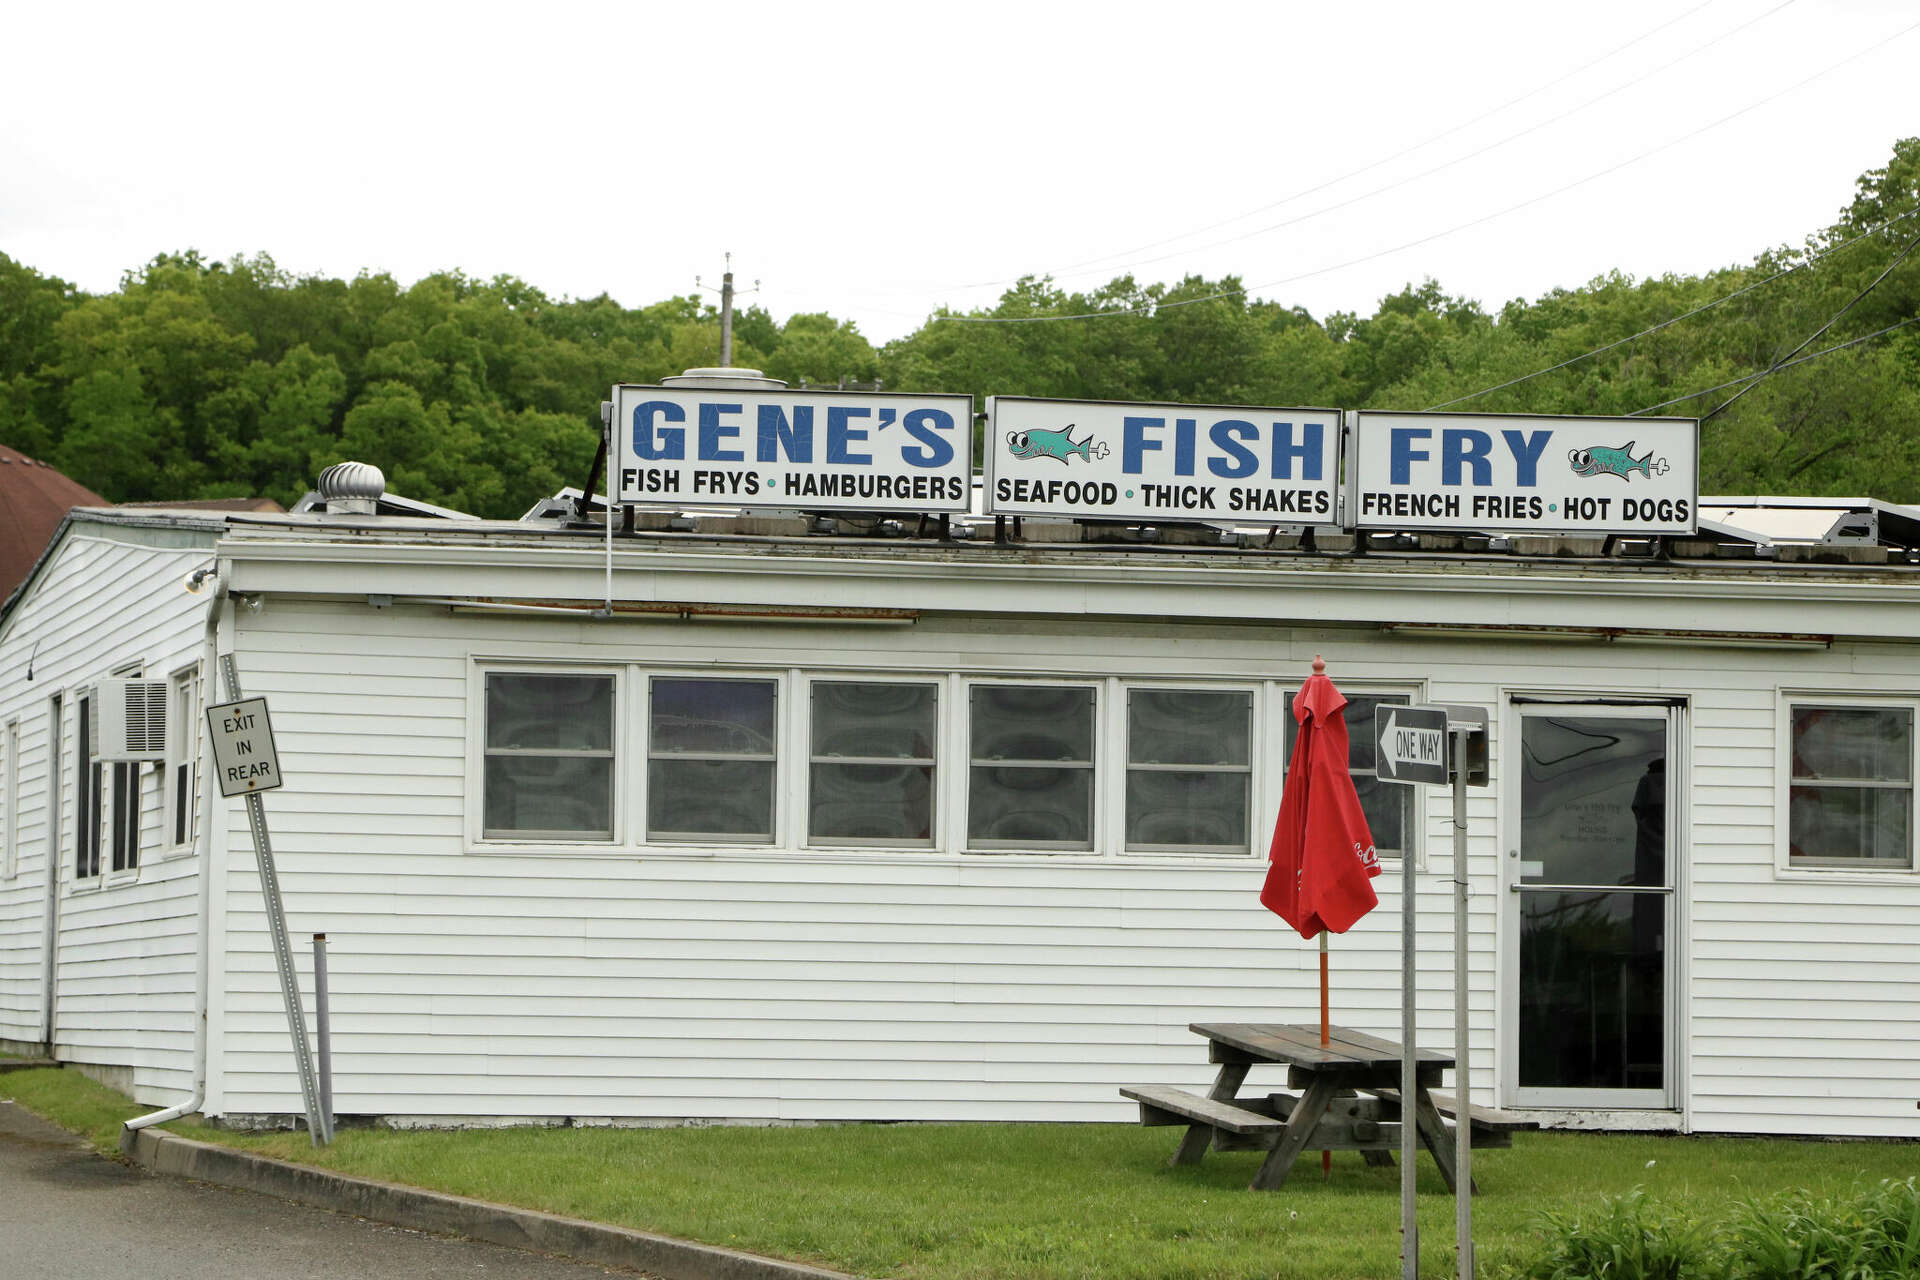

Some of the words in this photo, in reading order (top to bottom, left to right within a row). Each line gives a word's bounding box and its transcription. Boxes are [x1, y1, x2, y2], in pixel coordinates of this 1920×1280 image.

[632, 400, 955, 469] GENE'S
[1123, 417, 1323, 480] FISH
[1390, 428, 1554, 487] FRY
[621, 468, 680, 493] FISH
[694, 471, 759, 495] FRYS
[786, 473, 962, 500] HAMBURGERS
[997, 479, 1117, 505] SEAFOOD
[1141, 484, 1215, 509] THICK
[1229, 488, 1329, 513] SHAKES
[1363, 493, 1459, 517] FRENCH
[1473, 496, 1542, 519] FRIES
[1564, 498, 1611, 520] HOT
[1623, 499, 1688, 522] DOGS
[223, 714, 255, 734] EXIT
[236, 740, 253, 756] IN
[1397, 731, 1416, 758] ONE
[1419, 734, 1439, 760] WAY
[228, 762, 270, 781] REAR
